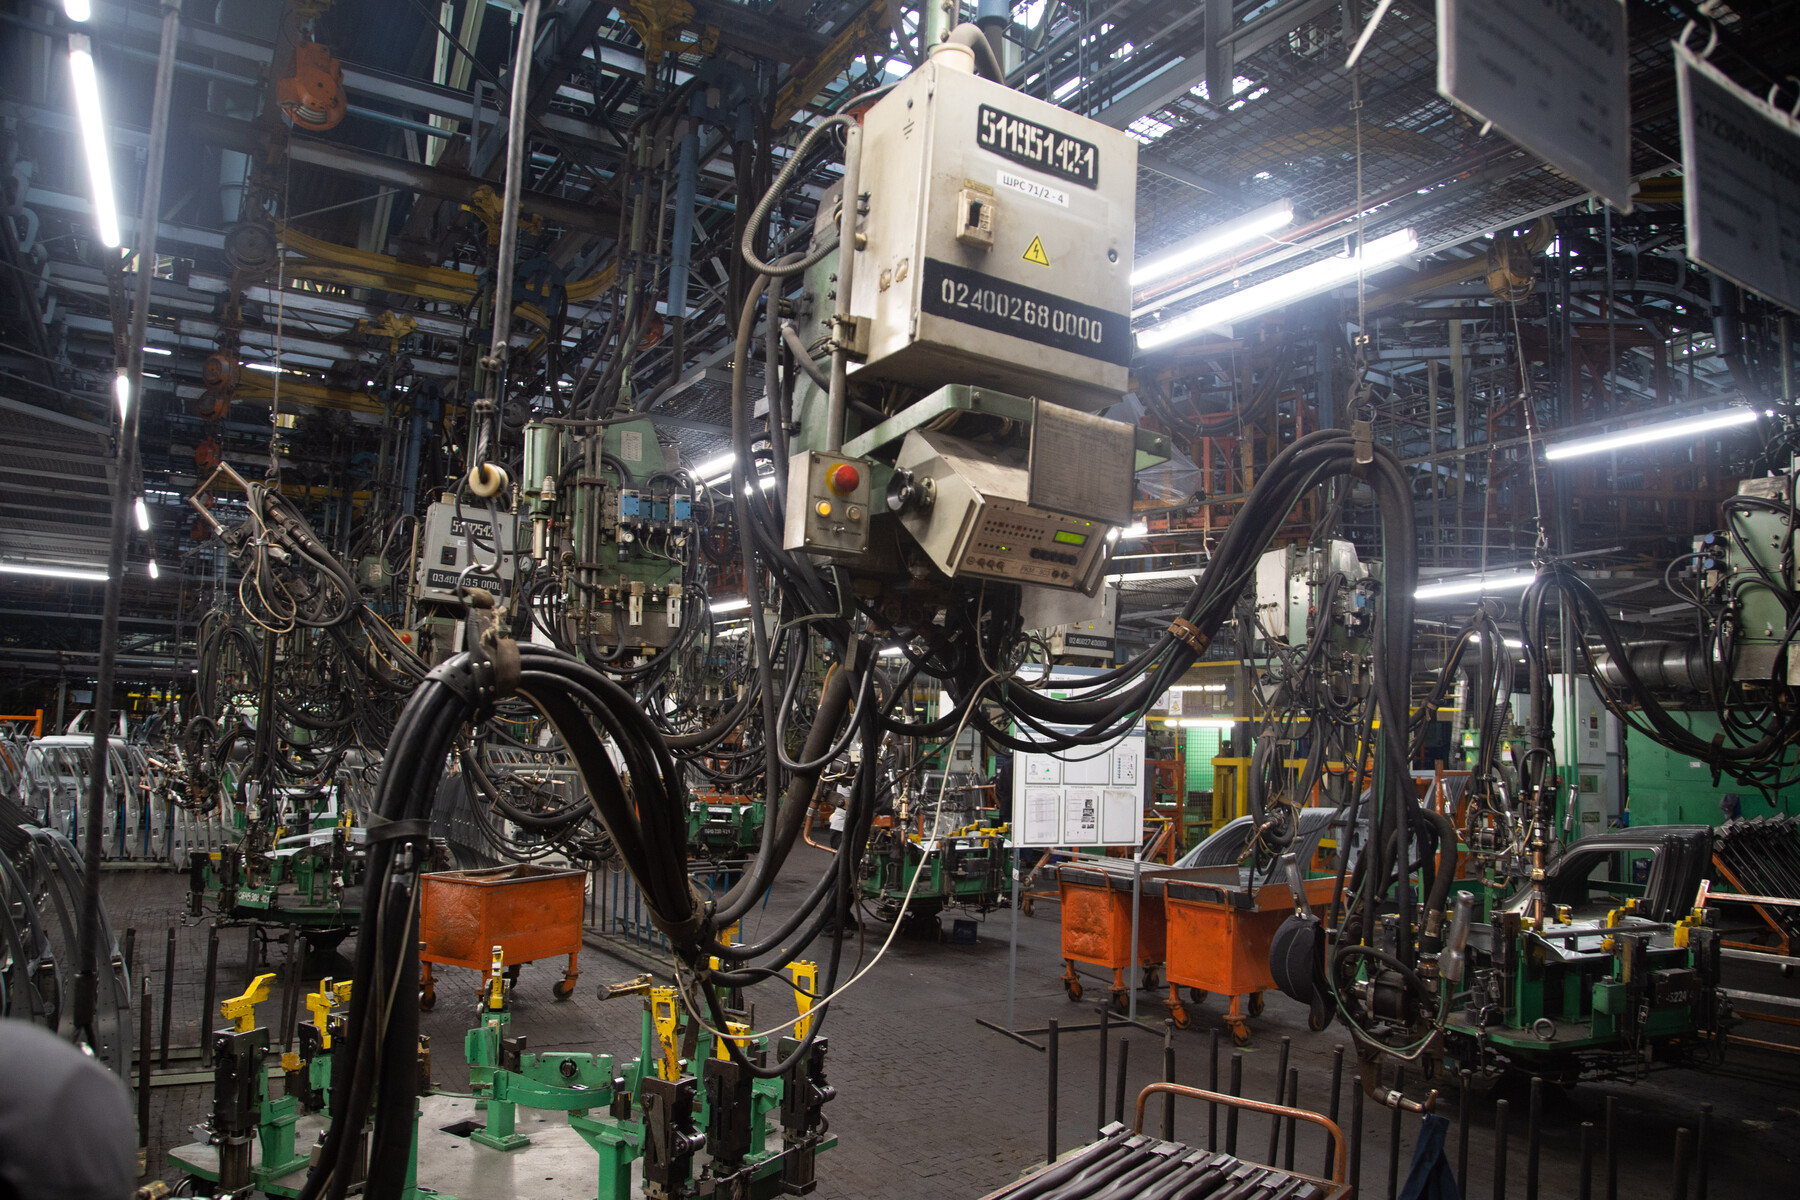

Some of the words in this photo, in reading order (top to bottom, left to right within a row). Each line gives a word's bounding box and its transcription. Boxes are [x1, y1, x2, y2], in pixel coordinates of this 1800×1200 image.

[1002, 175, 1026, 191] ШРС
[1028, 183, 1050, 198] 71/2
[1057, 194, 1064, 203] 4
